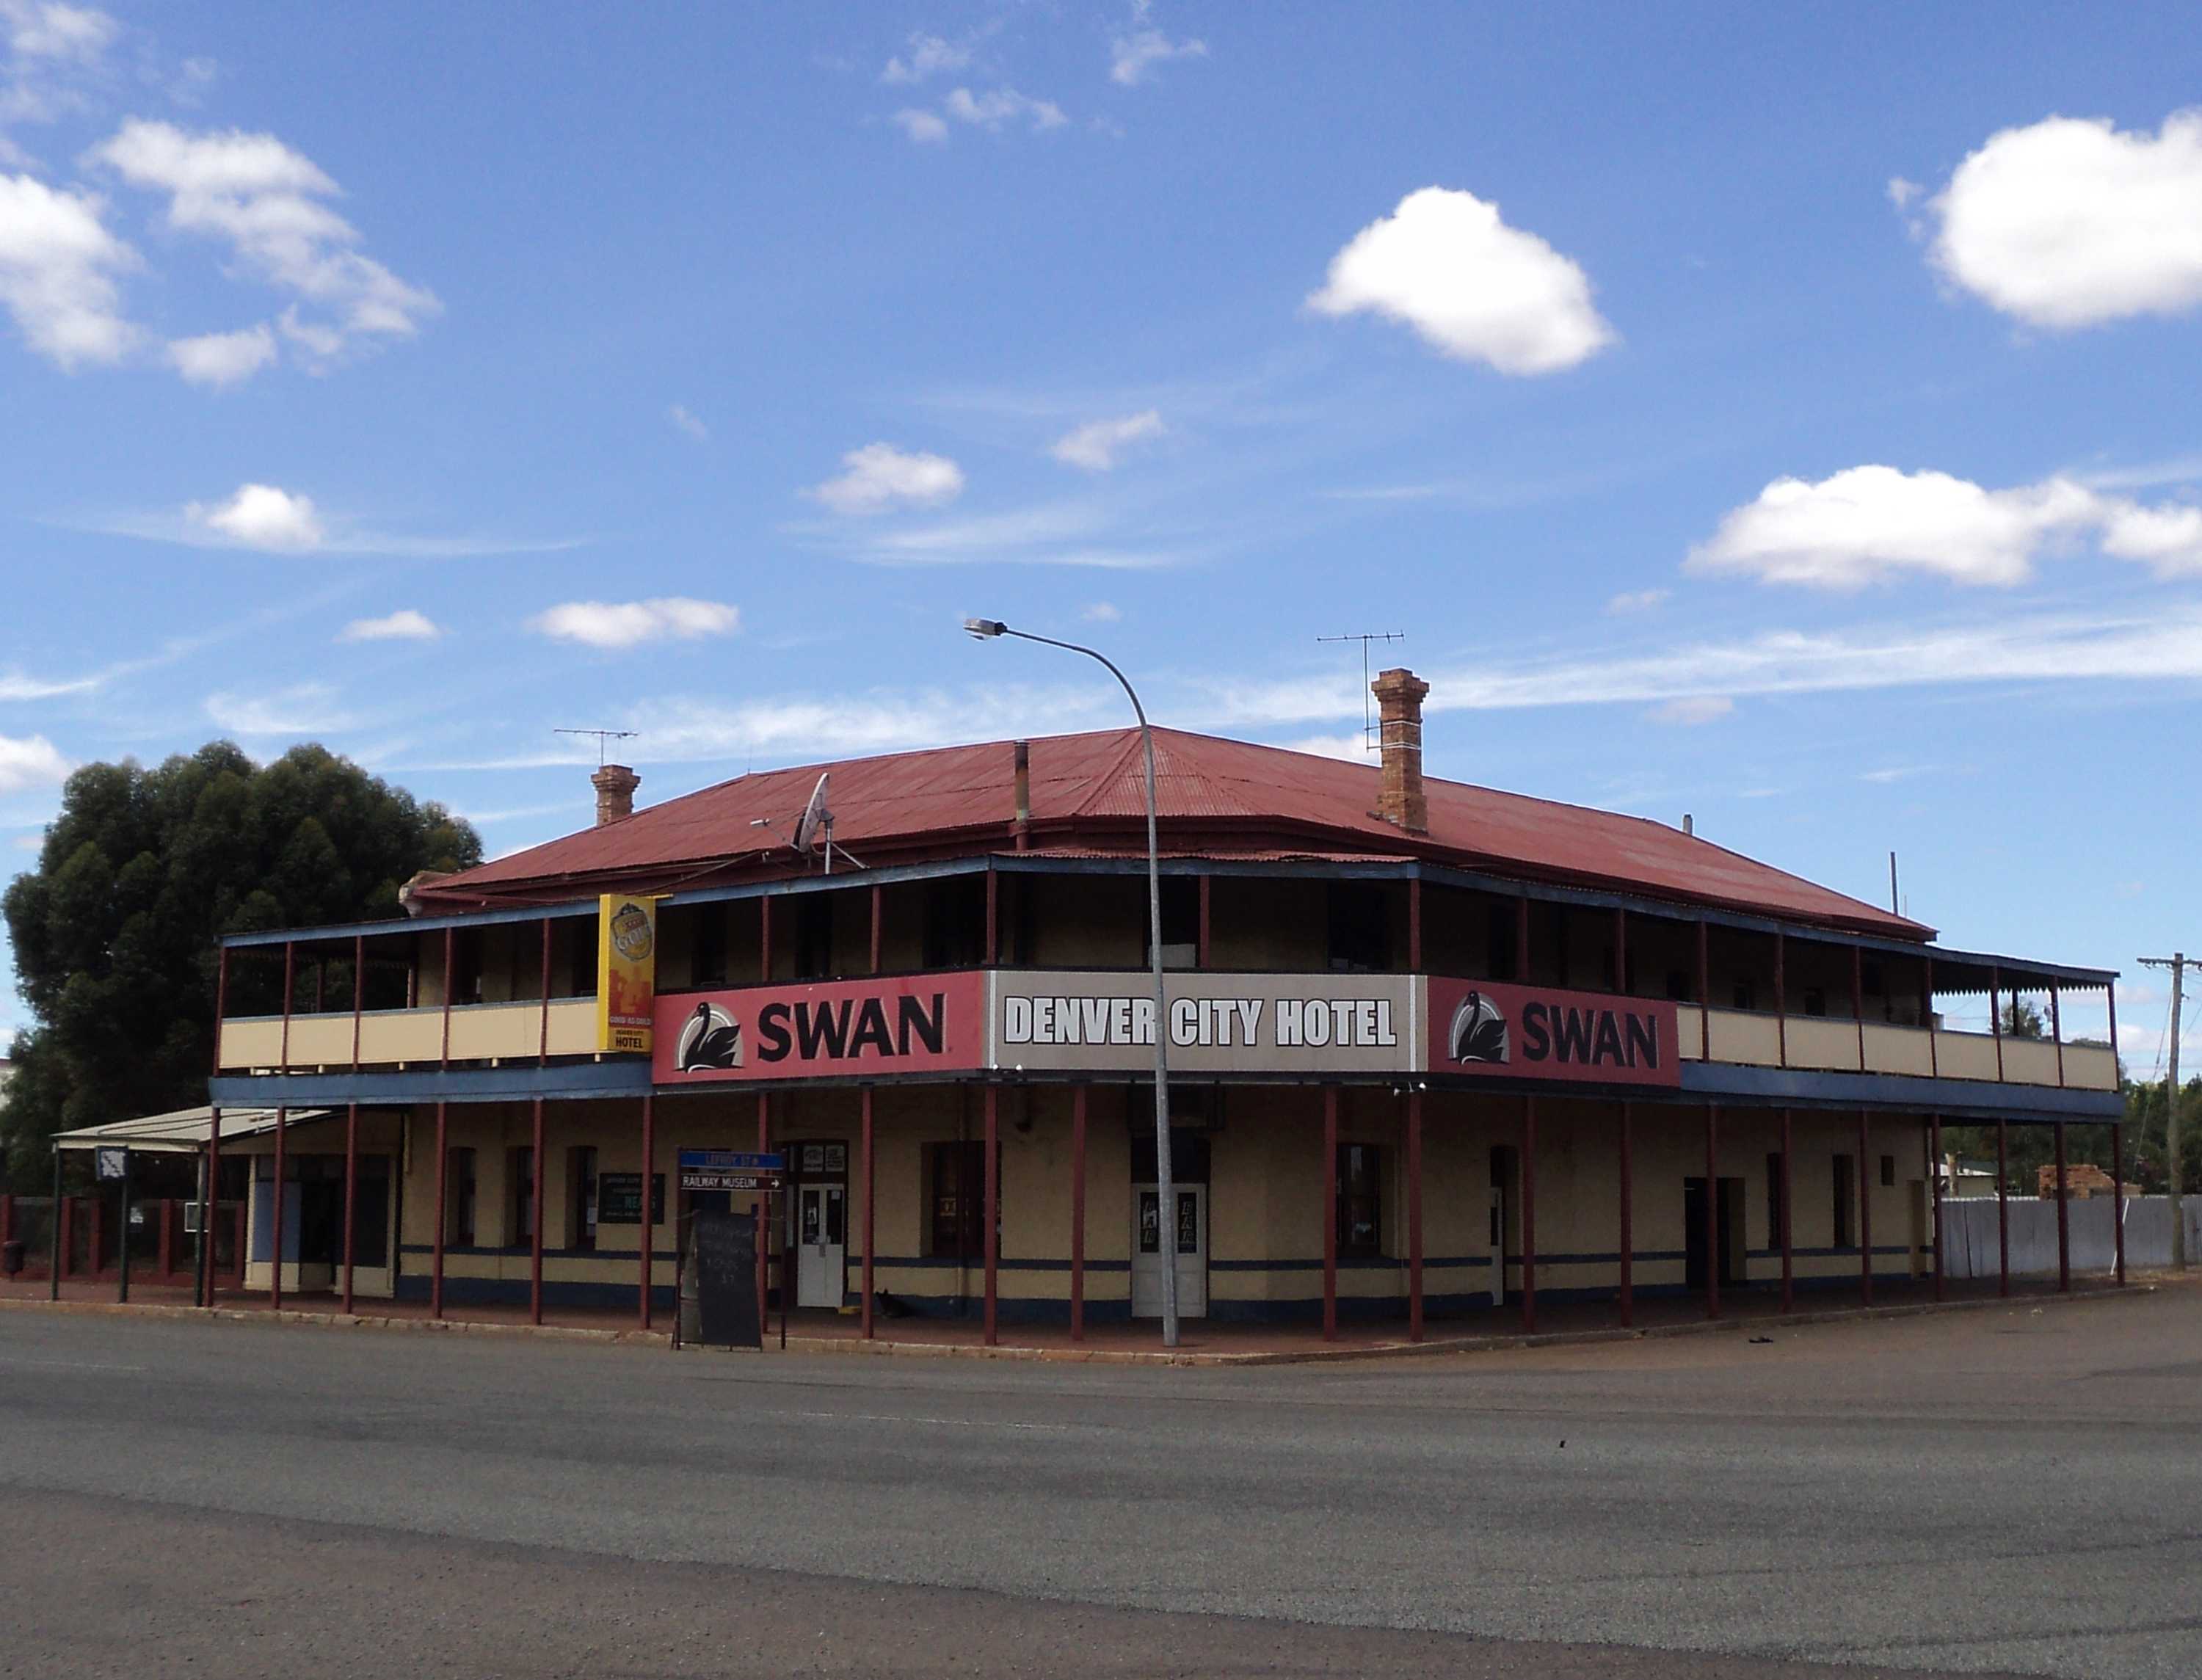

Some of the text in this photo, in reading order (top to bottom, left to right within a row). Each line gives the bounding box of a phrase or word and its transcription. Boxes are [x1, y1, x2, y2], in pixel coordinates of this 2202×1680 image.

[615, 1036, 644, 1049] HOTEL
[758, 992, 947, 1062] SWAN
[1003, 996, 1398, 1047] DENVER CITY HOTEL
[1522, 1002, 1660, 1069] SWAN
[682, 1176, 757, 1188] RAILWAY MUSEUM
